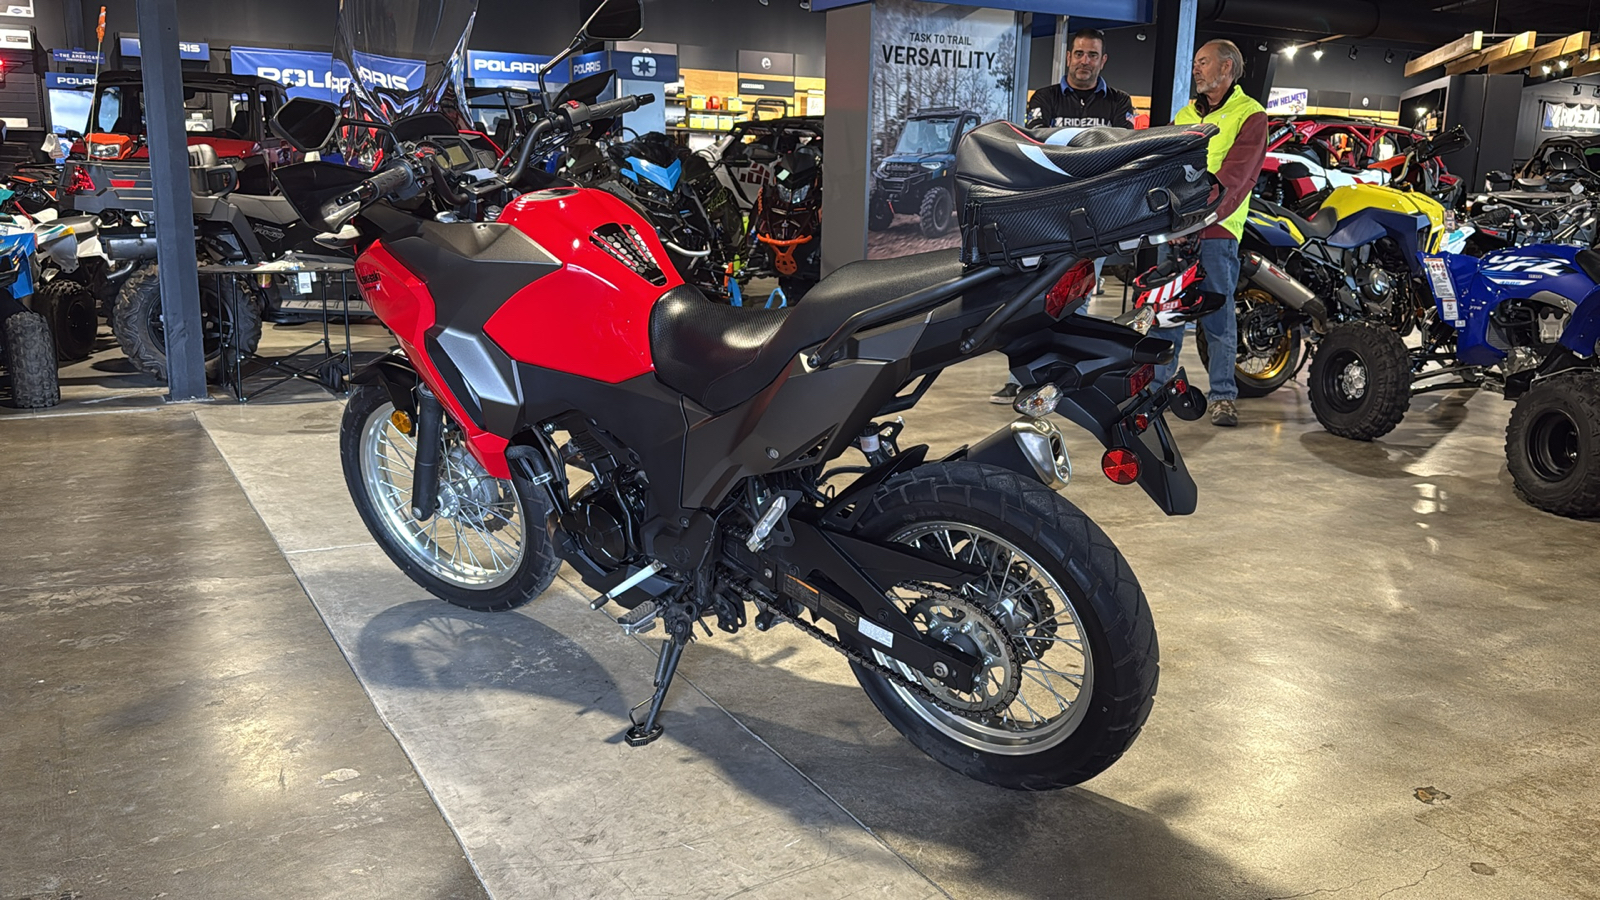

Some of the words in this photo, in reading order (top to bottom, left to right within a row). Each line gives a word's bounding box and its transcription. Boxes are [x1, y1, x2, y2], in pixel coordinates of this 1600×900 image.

[910, 32, 932, 43] TASK
[934, 34, 945, 44] TO
[948, 35, 972, 46] TRAIL
[882, 44, 996, 70] VERSATILITY
[573, 60, 602, 75] POLARIS
[1280, 91, 1307, 106] HELMETS
